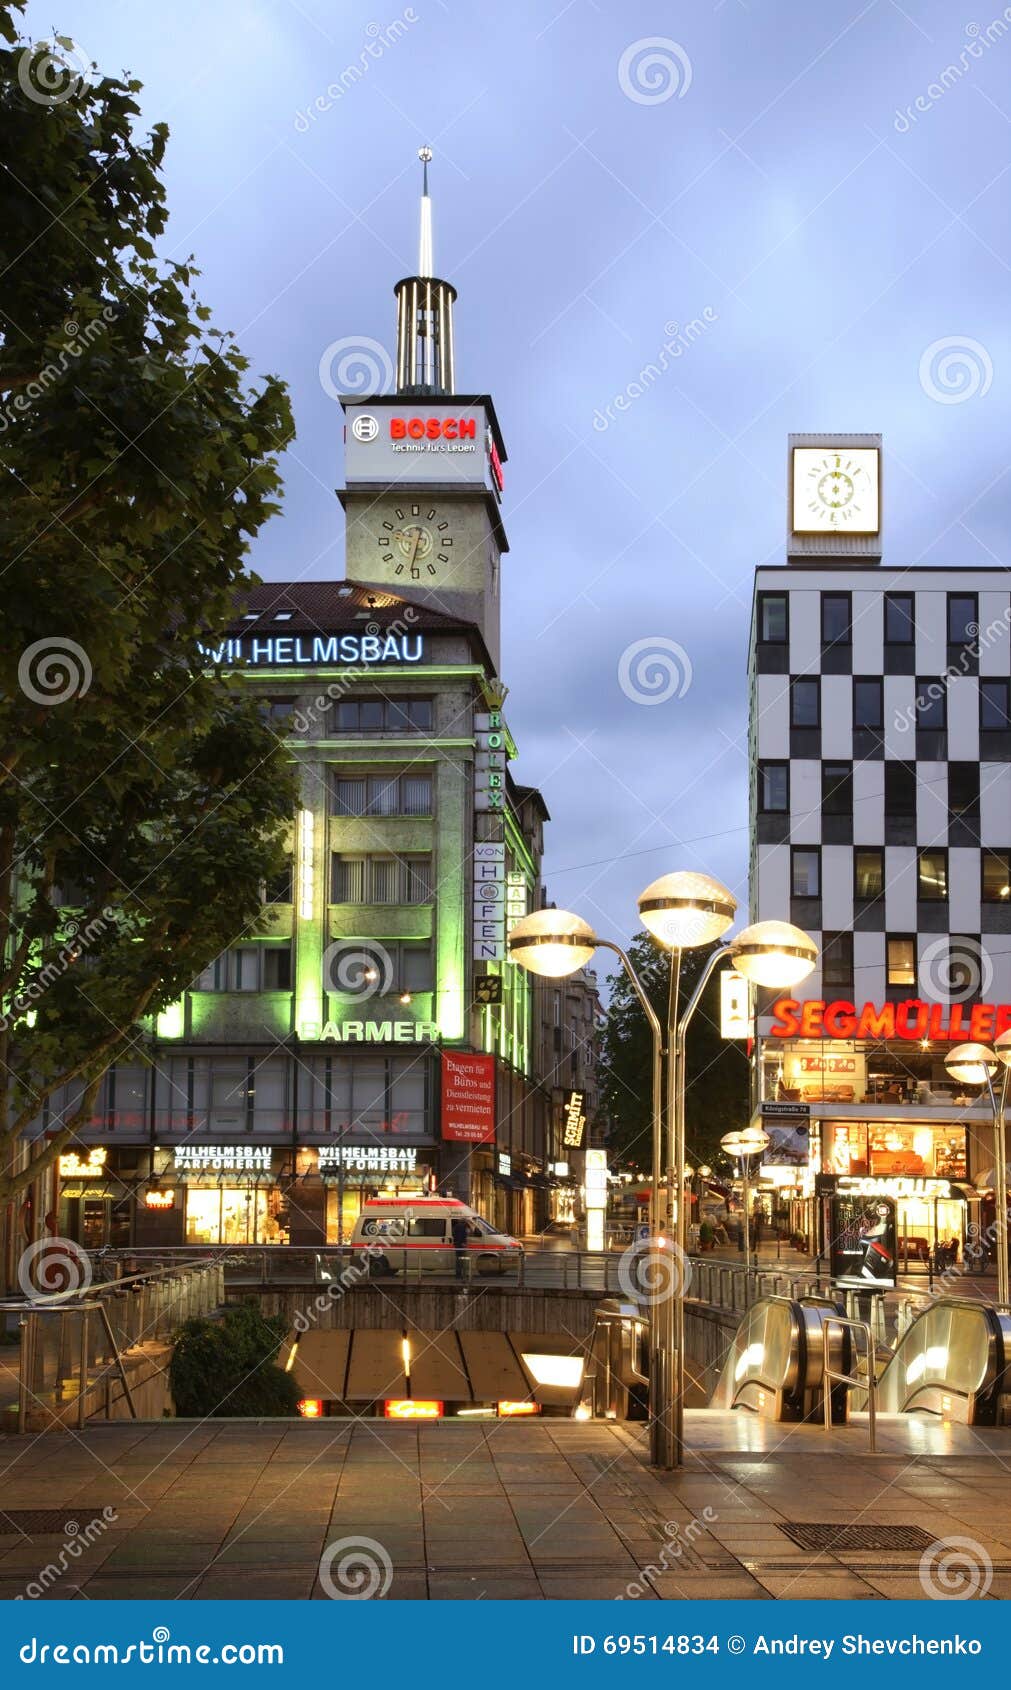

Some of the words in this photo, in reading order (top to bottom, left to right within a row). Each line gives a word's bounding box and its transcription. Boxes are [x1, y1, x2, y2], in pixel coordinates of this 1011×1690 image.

[390, 418, 476, 439] BOSCH
[391, 443, 425, 453] Technik
[447, 443, 475, 453] Leben
[488, 713, 502, 809] ROLEX
[476, 848, 503, 857] VON
[480, 866, 499, 958] HOFEN
[299, 1021, 441, 1041] BARMER
[446, 1060, 474, 1075] Etagen
[454, 1075, 478, 1088] Büros
[479, 1082, 492, 1090] und
[446, 1089, 492, 1103] Dienstleistung
[456, 1103, 492, 1115] vermieten
[173, 1147, 272, 1157] WILHELMSBAU
